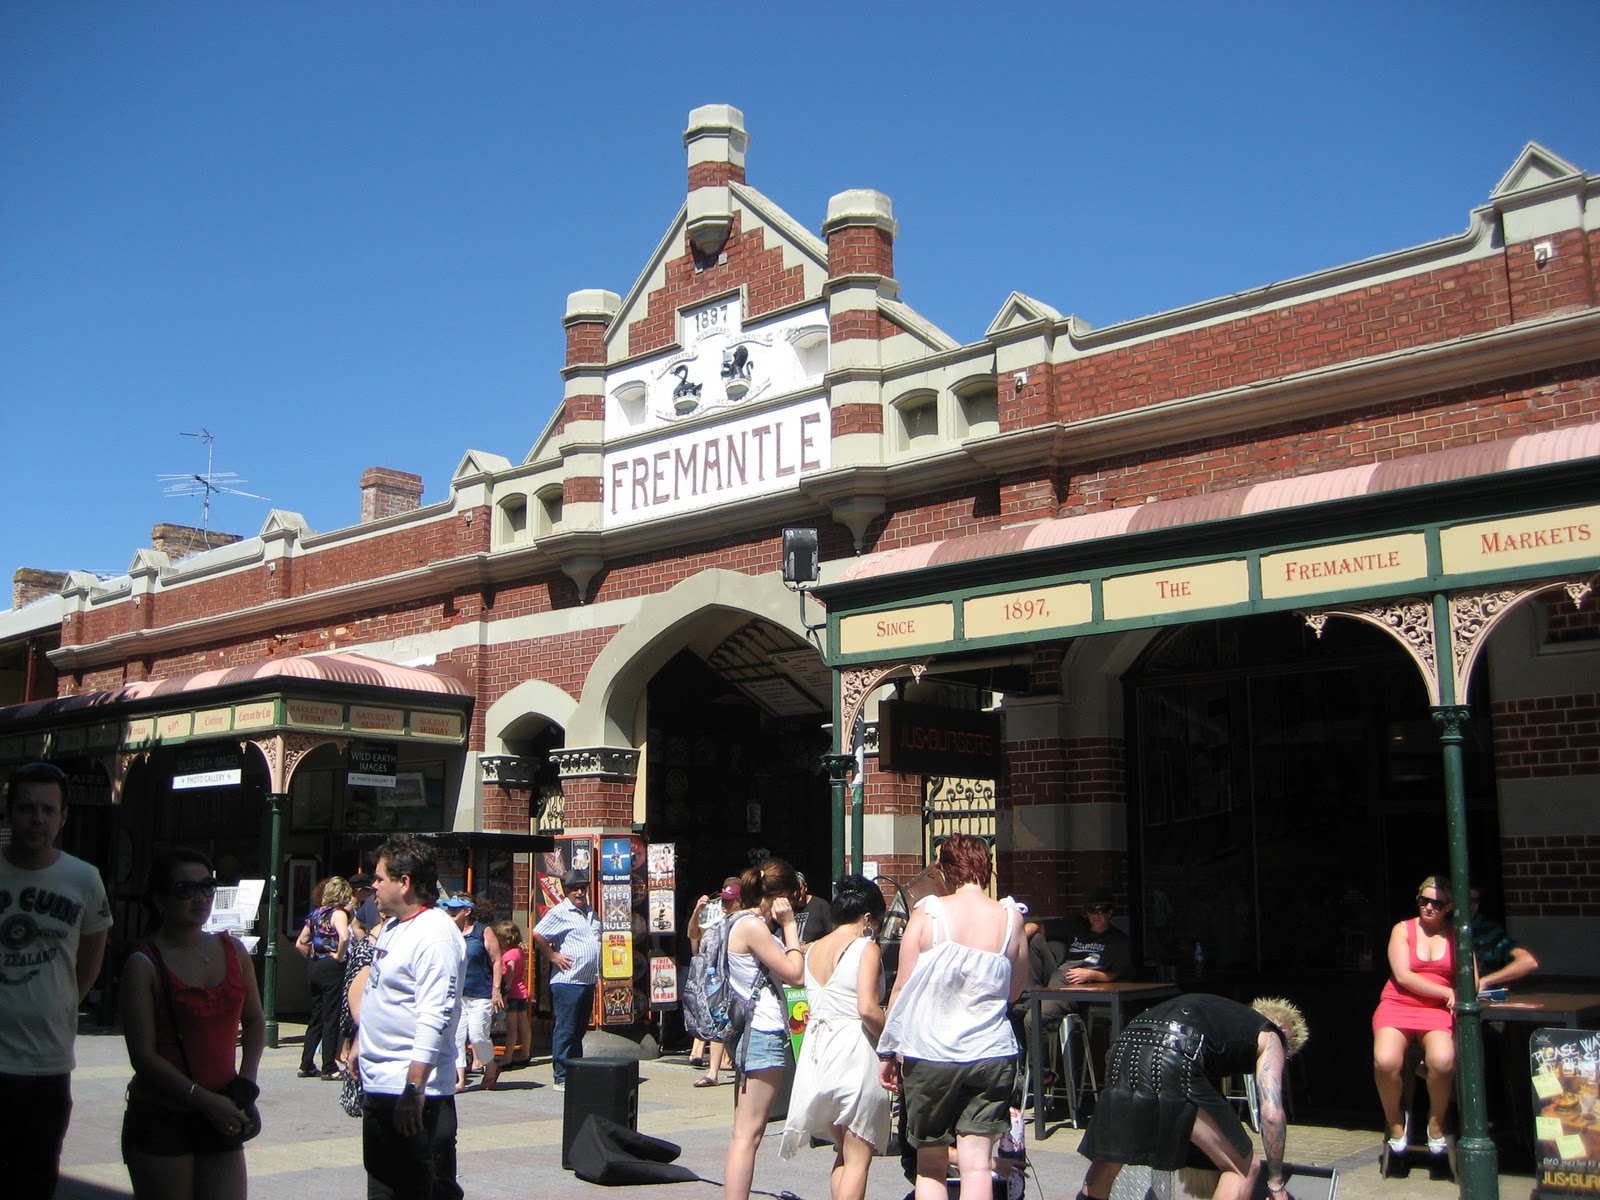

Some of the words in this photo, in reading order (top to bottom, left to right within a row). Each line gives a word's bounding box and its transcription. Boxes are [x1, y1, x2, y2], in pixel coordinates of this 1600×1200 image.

[695, 305, 728, 332] 1897
[611, 412, 821, 515] FREMANTLE
[876, 619, 915, 638] SINCE
[1003, 598, 1050, 621] 1897,
[1156, 580, 1191, 600] THE
[1285, 551, 1400, 582] FREMANTLE
[1480, 523, 1592, 555] MARKETS
[290, 705, 319, 715] MARKET
[320, 707, 338, 716] OPEN
[301, 714, 325, 723] FRIDAY
[356, 711, 396, 722] SATURDAY
[361, 721, 390, 730] SUNDAY
[420, 717, 450, 727] HOLIDAY
[420, 726, 449, 735] MONDAY
[351, 751, 371, 761] WILD
[372, 753, 397, 763] EARTH
[360, 763, 388, 772] IMAGES
[187, 775, 204, 784] PHOTO
[204, 774, 225, 783] GALLERY
[603, 892, 630, 900] SHED
[603, 922, 632, 930] RULES
[4, 947, 57, 967] ZEALAND
[1531, 1043, 1579, 1063] PLEASE
